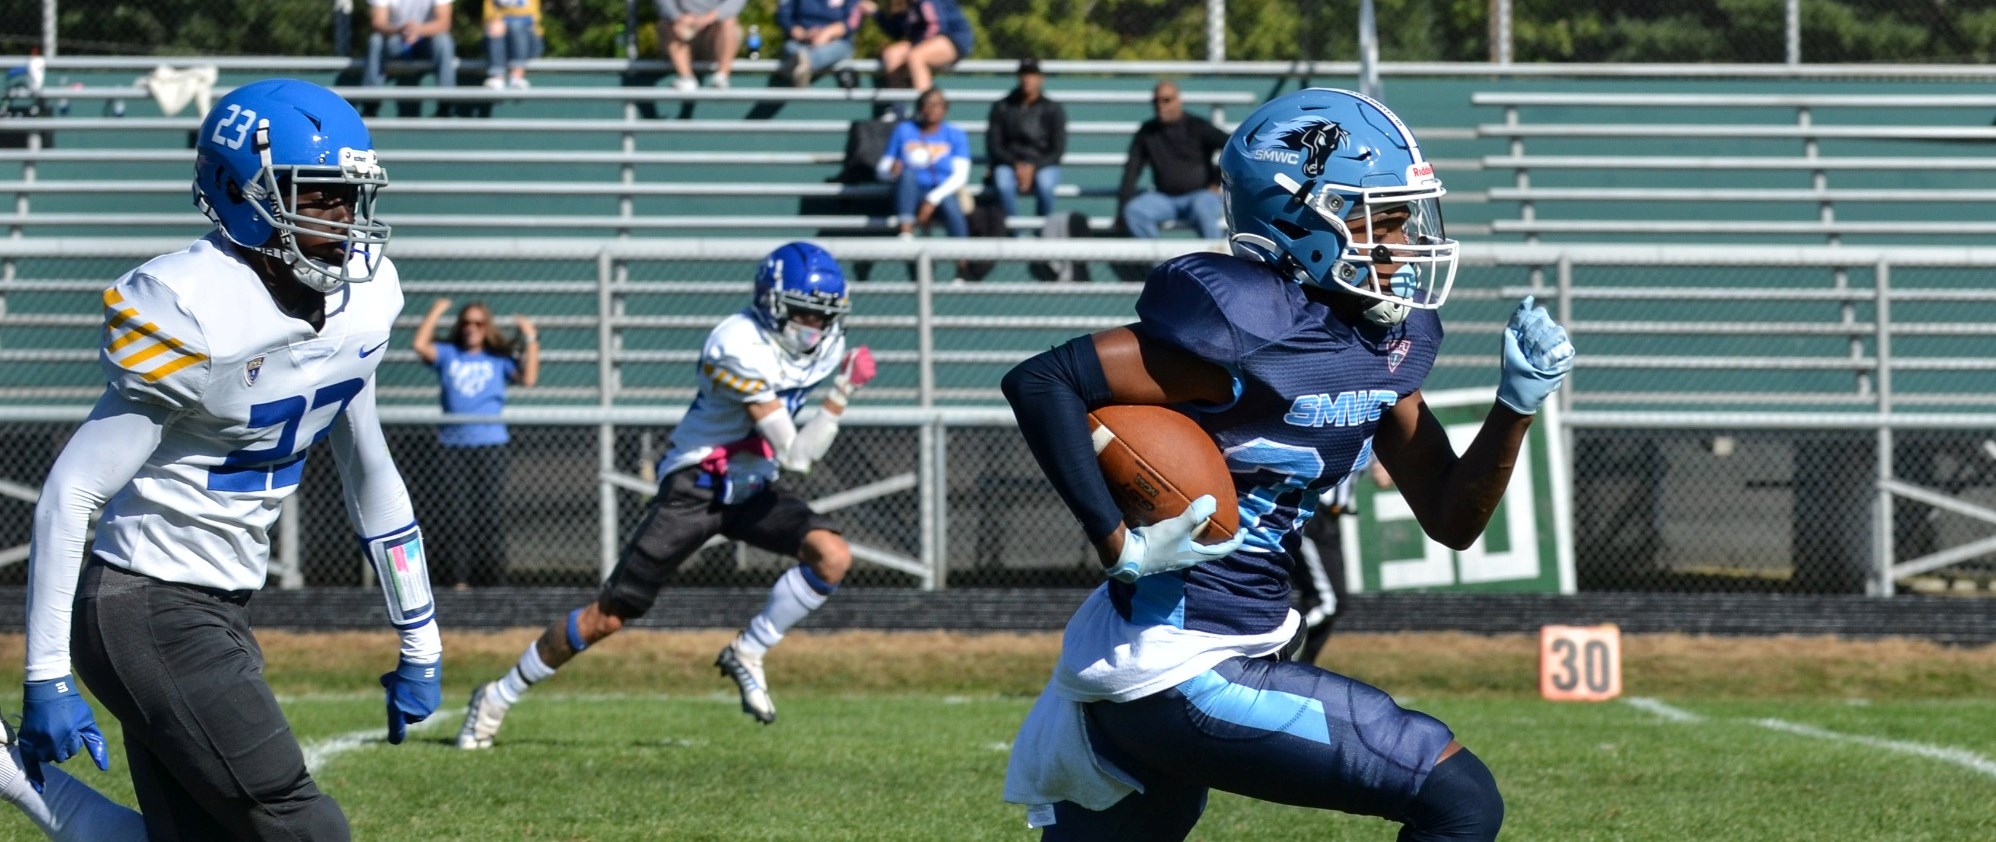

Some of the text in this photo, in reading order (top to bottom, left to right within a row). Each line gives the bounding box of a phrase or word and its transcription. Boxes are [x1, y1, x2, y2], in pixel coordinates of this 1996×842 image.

[212, 104, 257, 150] 23
[1254, 149, 1299, 165] SMWC
[1283, 389, 1398, 428] SMWC
[1552, 639, 1610, 693] 30
